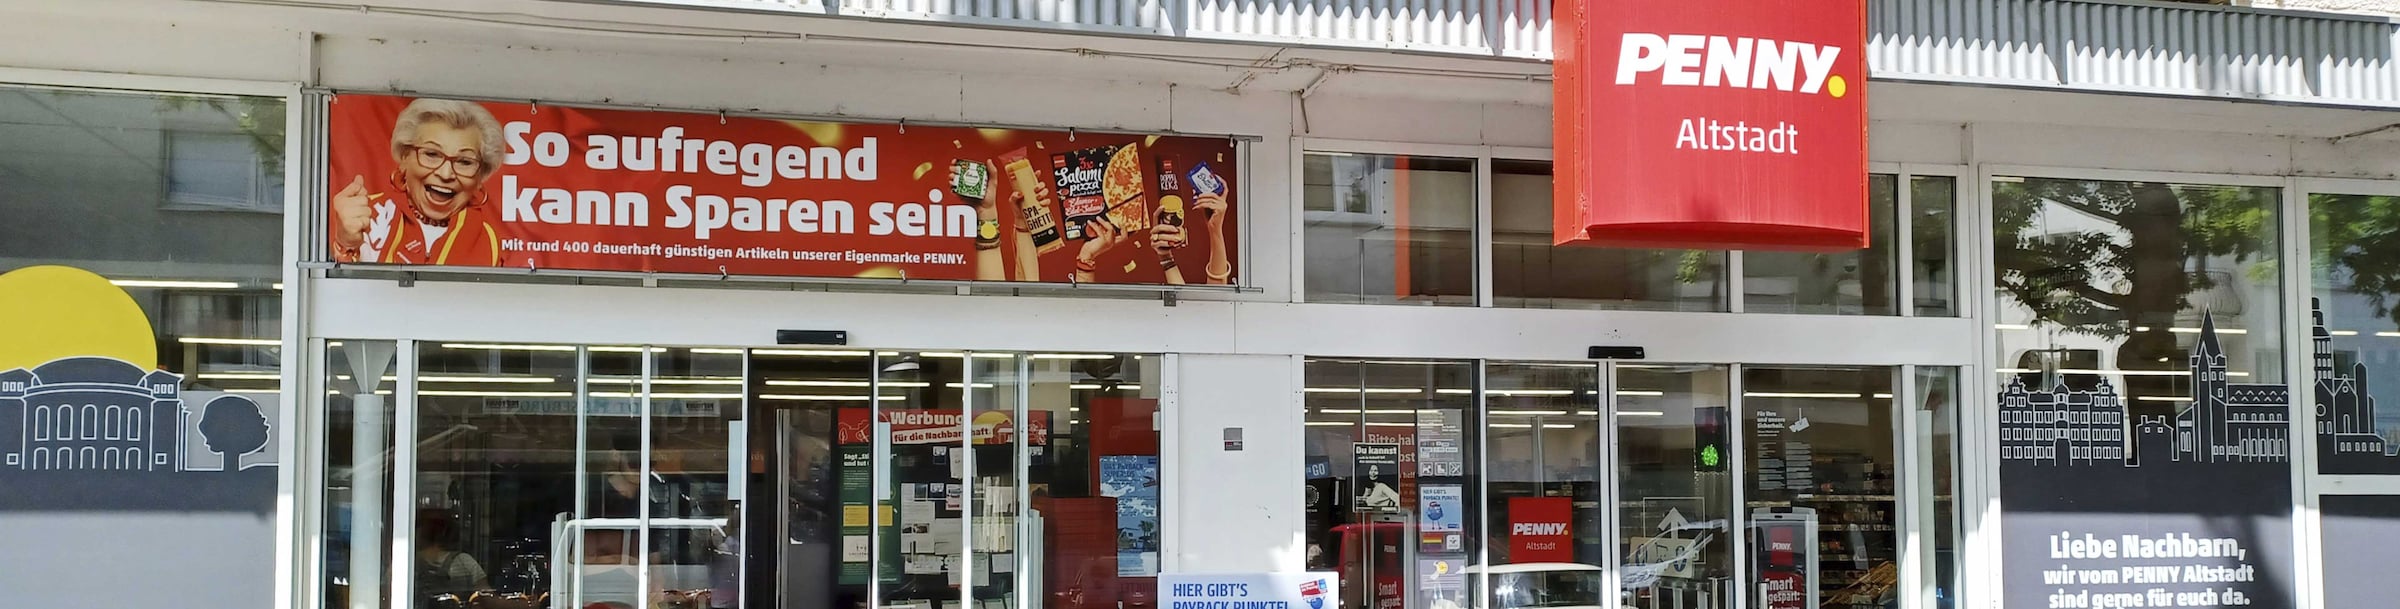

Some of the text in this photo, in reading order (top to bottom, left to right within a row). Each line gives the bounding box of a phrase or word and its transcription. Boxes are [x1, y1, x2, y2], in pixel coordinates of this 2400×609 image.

[1615, 33, 1846, 97] PENNY.
[1676, 117, 1798, 154] Altstadt
[503, 121, 877, 187] So aufregend
[1054, 162, 1103, 187] Salami
[1069, 181, 1100, 197] pizza
[502, 175, 977, 239] kann Sparen sein
[1022, 205, 1042, 219] SPA-
[501, 239, 966, 265] Mit rund 400 dauerhaft günstigen Artikeln unserer Eigenmarke PENNY.
[894, 434, 908, 442] für
[909, 432, 923, 441] die
[1368, 434, 1395, 443] Bitte
[1356, 446, 1397, 455] Du kannst
[1312, 463, 1326, 476] GO
[1512, 522, 1568, 535] PENNY.
[1526, 542, 1556, 550] Altstadt
[1772, 542, 1792, 550] PENNY.
[2050, 531, 2246, 561] Liebe Nachbarn,
[2043, 563, 2254, 584] wir vom PENNY Altstadt
[1173, 583, 1248, 597] HIER GIBT'S
[1379, 581, 1397, 596] Smart
[1173, 601, 1229, 609] PAYBACK
[1768, 590, 1801, 605] gespart:
[2049, 587, 2250, 609] sind gerne für euch da.
